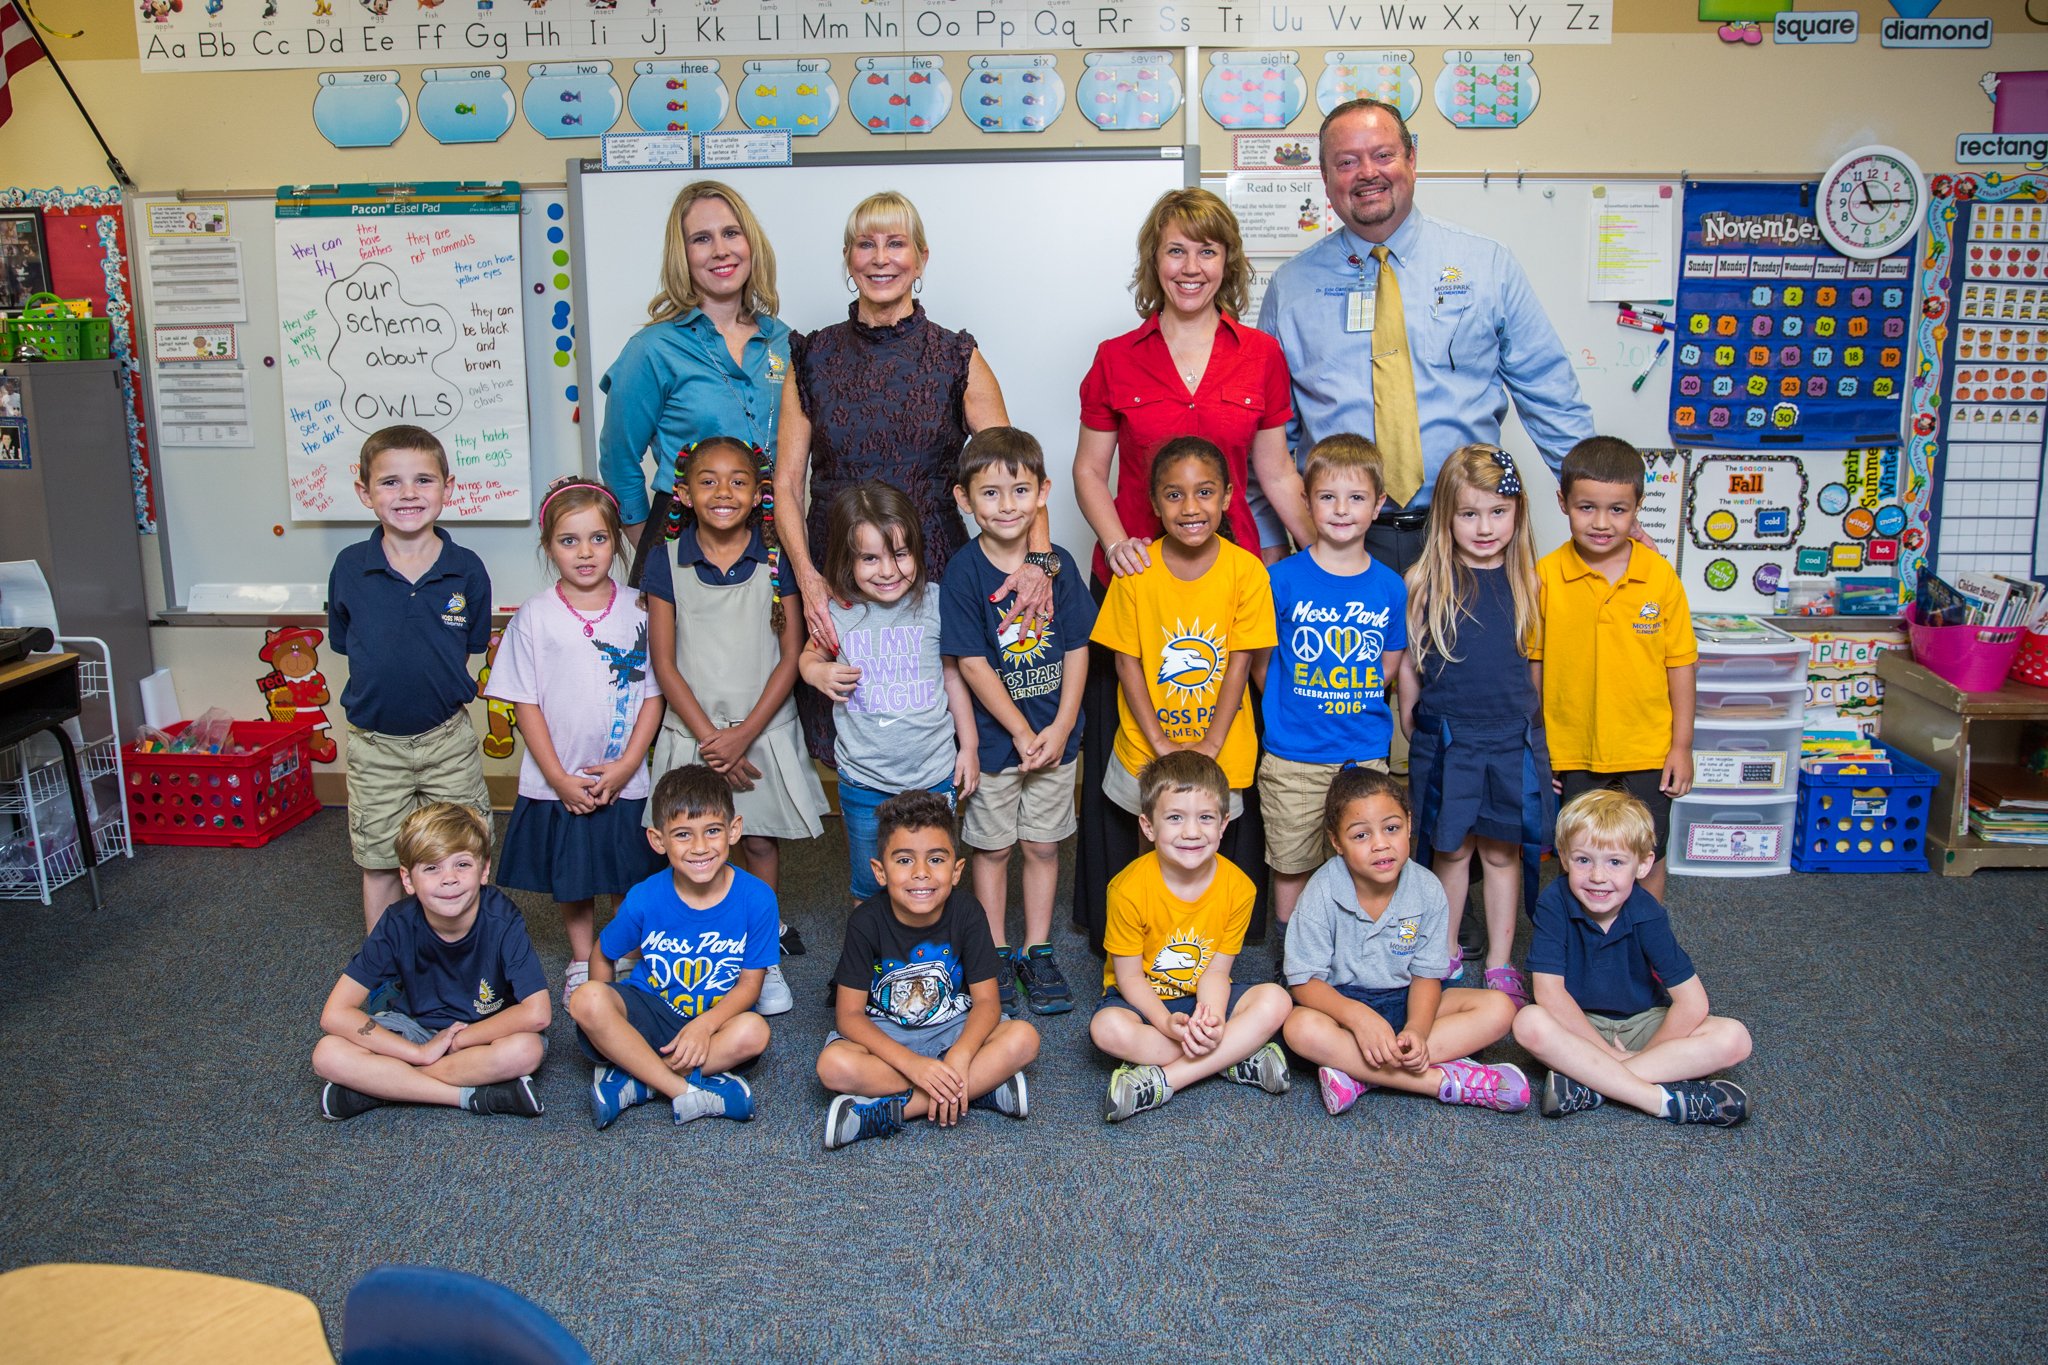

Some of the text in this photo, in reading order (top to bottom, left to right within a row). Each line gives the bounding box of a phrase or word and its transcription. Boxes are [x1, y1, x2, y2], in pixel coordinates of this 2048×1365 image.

[316, 18, 330, 28] dog
[371, 16, 384, 24] egg
[147, 4, 1600, 59] Aa Bb Cc Dd Ee Ff Gg Hh Ii Jj Kk Ll Mm Nn Oo Pp Qq Rr Ss Tt Uu Vv Ww Xx Yy Zz
[1777, 16, 1854, 42] square
[1884, 20, 1989, 40] diamond
[866, 56, 932, 70] 5 five
[980, 56, 1049, 68] 6 six
[1131, 54, 1164, 64] seven
[1222, 53, 1290, 66] 8 eight
[1337, 52, 1408, 64] 9 nine
[1457, 52, 1522, 62] 10 ten
[538, 64, 598, 76] 2 two
[646, 62, 709, 75] 3 three
[752, 60, 820, 72] 4 four
[327, 72, 388, 86] 0 zero
[433, 70, 491, 82] 1 one
[1960, 137, 2048, 160] rectang
[1867, 168, 1879, 179] 12
[1247, 182, 1312, 193] Read to Self
[1840, 182, 1852, 192] 10
[394, 204, 420, 214] Easel
[422, 204, 440, 213] Pad
[1842, 212, 1848, 222] 8
[357, 224, 378, 234] they
[359, 234, 381, 246] have
[406, 228, 451, 246] they are
[290, 238, 342, 260] they can
[359, 245, 392, 261] feathers
[410, 234, 476, 264] not mammals
[316, 260, 336, 280] fly
[454, 254, 515, 274] they can have
[1688, 260, 1906, 276] Sunday Monday Tuesday Wednesday Thursday Friday Saturday
[346, 282, 392, 301] our
[1434, 284, 1450, 292] MOSS
[470, 302, 514, 321] they can
[346, 306, 442, 337] schema
[1724, 321, 1730, 330] 7
[1820, 322, 1830, 332] 10
[1888, 323, 1899, 332] 12
[462, 321, 510, 336] be black
[476, 336, 496, 352] and
[366, 346, 428, 367] about
[1720, 351, 1730, 361] 14
[1818, 352, 1827, 362] 17
[1849, 352, 1859, 361] 18
[464, 358, 501, 372] brown
[1684, 380, 1697, 390] 20
[1876, 382, 1889, 392] 26
[290, 399, 332, 423] they can
[355, 392, 452, 420] OWLS
[1713, 412, 1725, 422] 28
[1777, 413, 1791, 423] 30
[300, 413, 334, 437] see in
[302, 424, 344, 456] the dark
[454, 428, 508, 450] they hatch
[456, 448, 512, 468] from eggs
[1645, 471, 1678, 484] Week
[1730, 474, 1763, 493] Fall
[456, 480, 502, 494] wings are
[470, 489, 519, 504] from other
[1733, 498, 1765, 506] weather
[458, 505, 482, 516] birds
[1764, 517, 1781, 526] cold
[1848, 517, 1870, 532] windy
[1876, 546, 1890, 554] hot
[1805, 556, 1821, 564] cool
[1958, 579, 1981, 597] Chicken
[1292, 600, 1390, 628] Moss Park
[844, 626, 925, 658] IN MY
[850, 654, 920, 686] OWN
[1294, 662, 1384, 690] EAGLE
[258, 671, 285, 692] red
[1294, 687, 1350, 700] CELEBRATING
[1324, 701, 1362, 714] 2016
[641, 930, 748, 954] Moss Park
